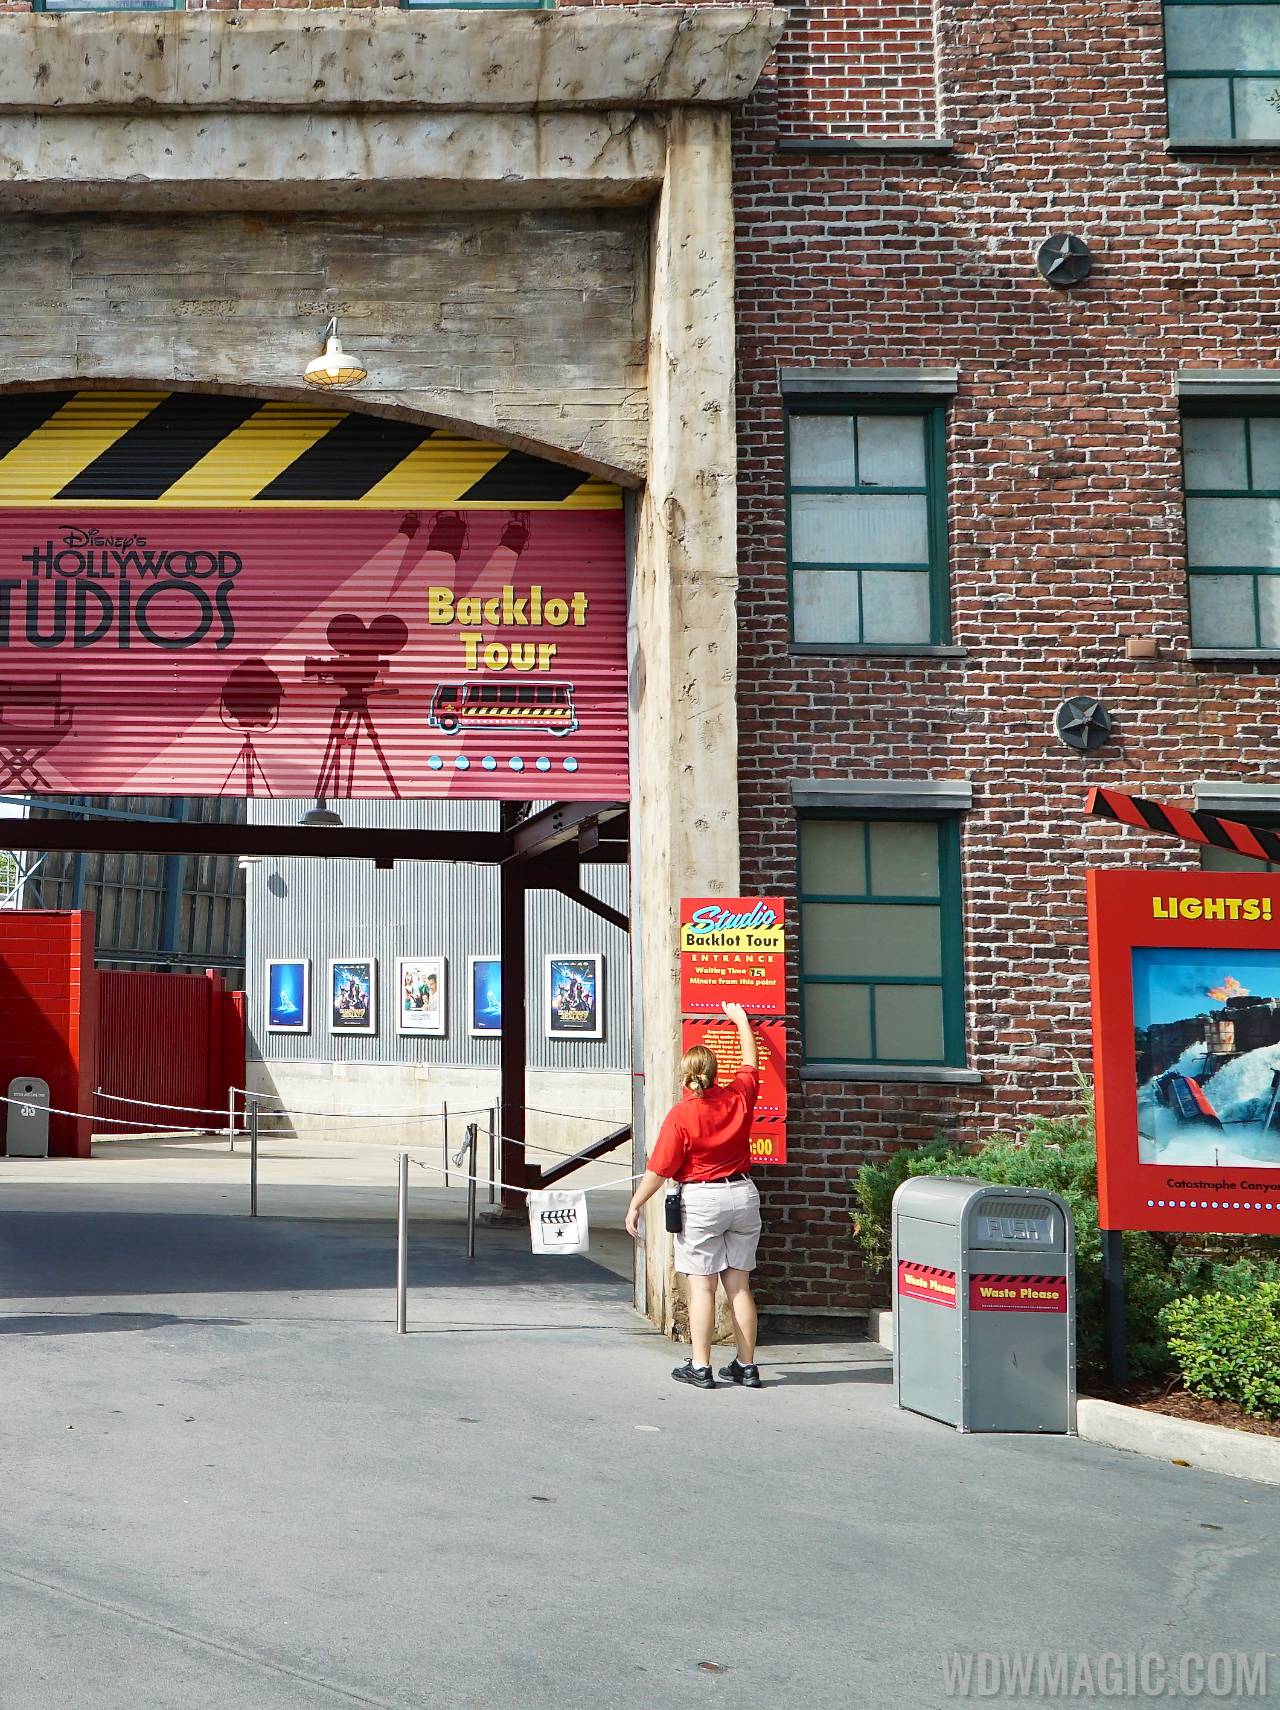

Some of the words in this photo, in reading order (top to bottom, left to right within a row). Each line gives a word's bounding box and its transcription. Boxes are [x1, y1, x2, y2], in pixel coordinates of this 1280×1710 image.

[22, 541, 243, 579] HOLLYWOOD
[428, 585, 588, 626] Backlot
[459, 632, 557, 671] Tour
[689, 901, 777, 934] Studio
[1152, 896, 1272, 921] LIGHTS!
[686, 934, 740, 946] Backlot
[746, 934, 779, 946] Tour
[691, 954, 774, 962] ENTRANCE
[695, 967, 726, 975] Waiting
[718, 977, 738, 985] from
[1166, 1178, 1237, 1191] Catastrophe
[986, 1217, 1040, 1240] PUSH
[904, 1273, 928, 1289] Waste
[929, 1279, 956, 1296] Please
[980, 1287, 1016, 1299] Waste
[1020, 1287, 1059, 1300] Please
